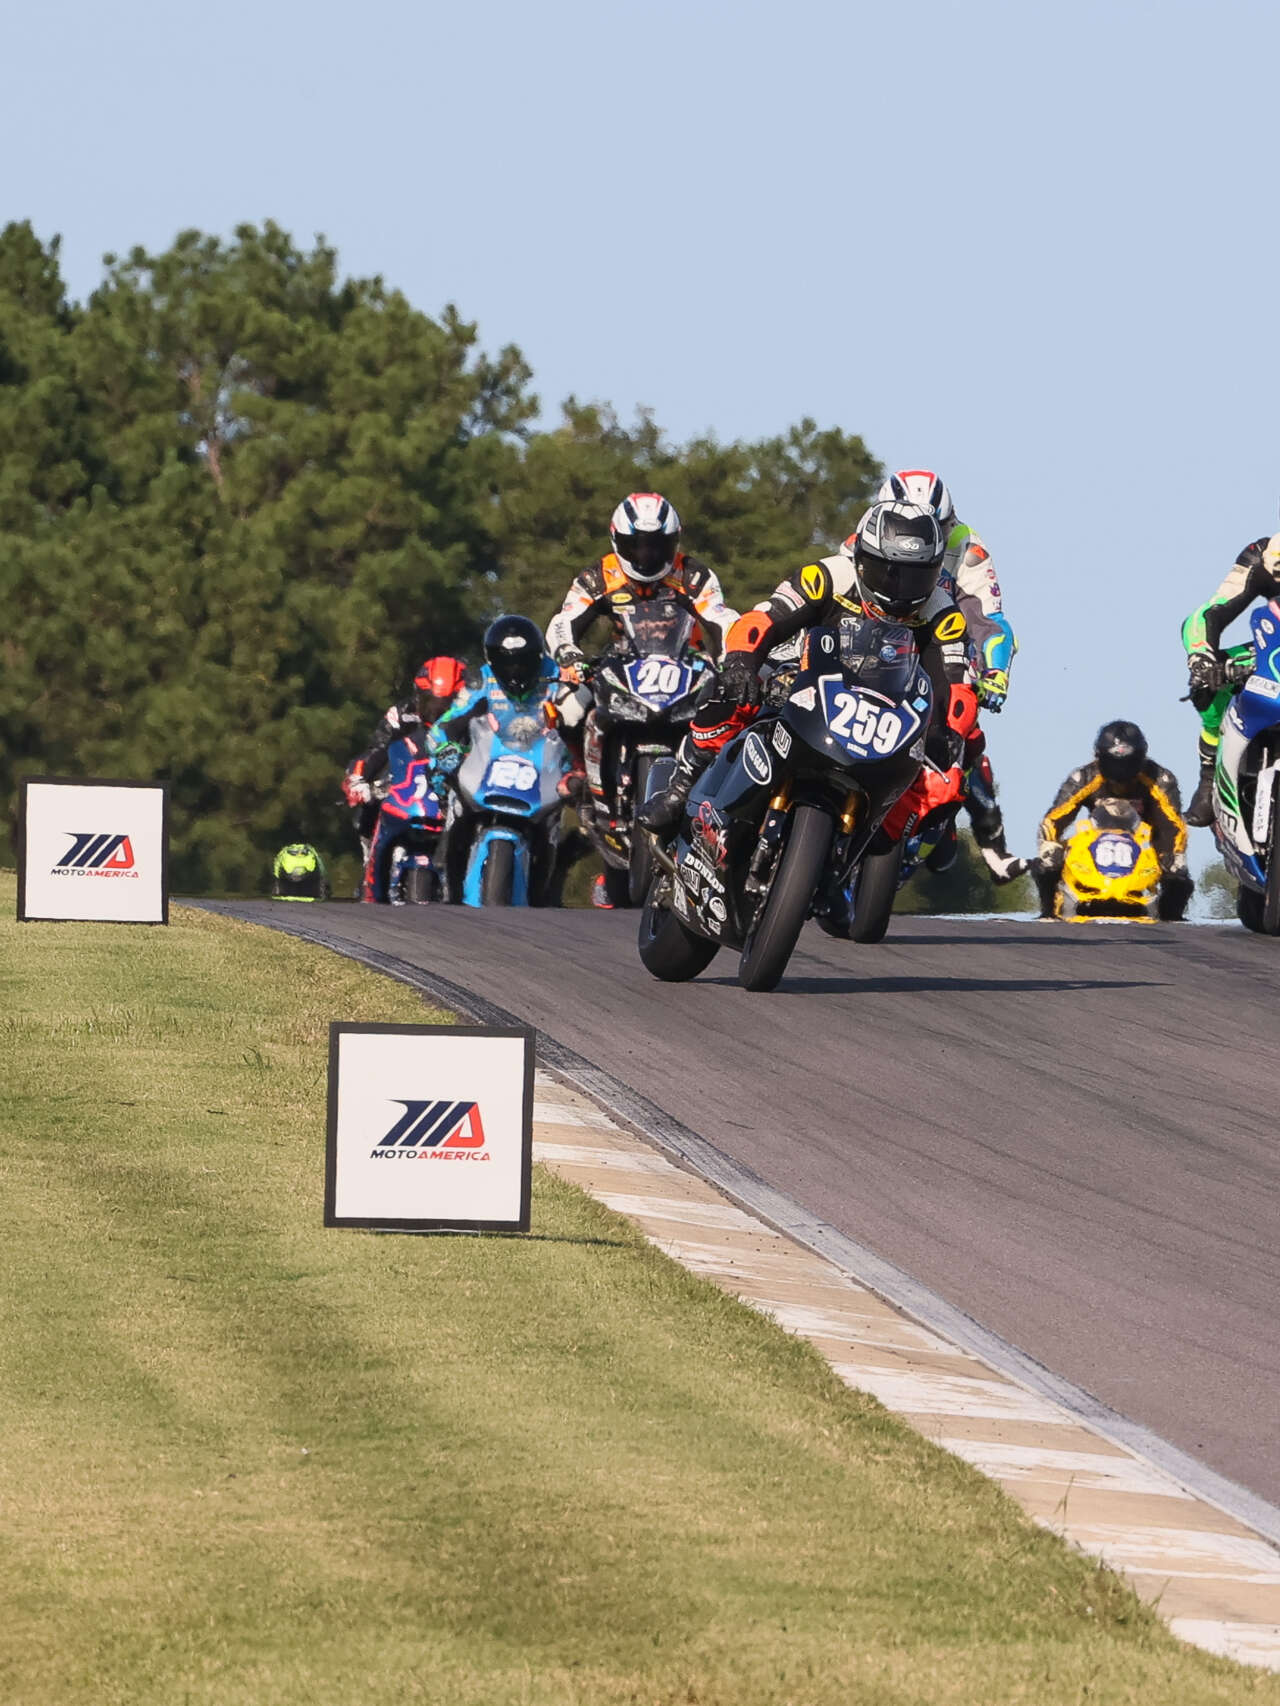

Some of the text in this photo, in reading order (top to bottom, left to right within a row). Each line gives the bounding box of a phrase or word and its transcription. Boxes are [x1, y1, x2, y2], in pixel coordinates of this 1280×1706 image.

[637, 661, 682, 694] 20
[829, 692, 902, 754] 259
[50, 868, 140, 879] MOTOAMERICA
[370, 1149, 491, 1162] MOTOAMERICA
